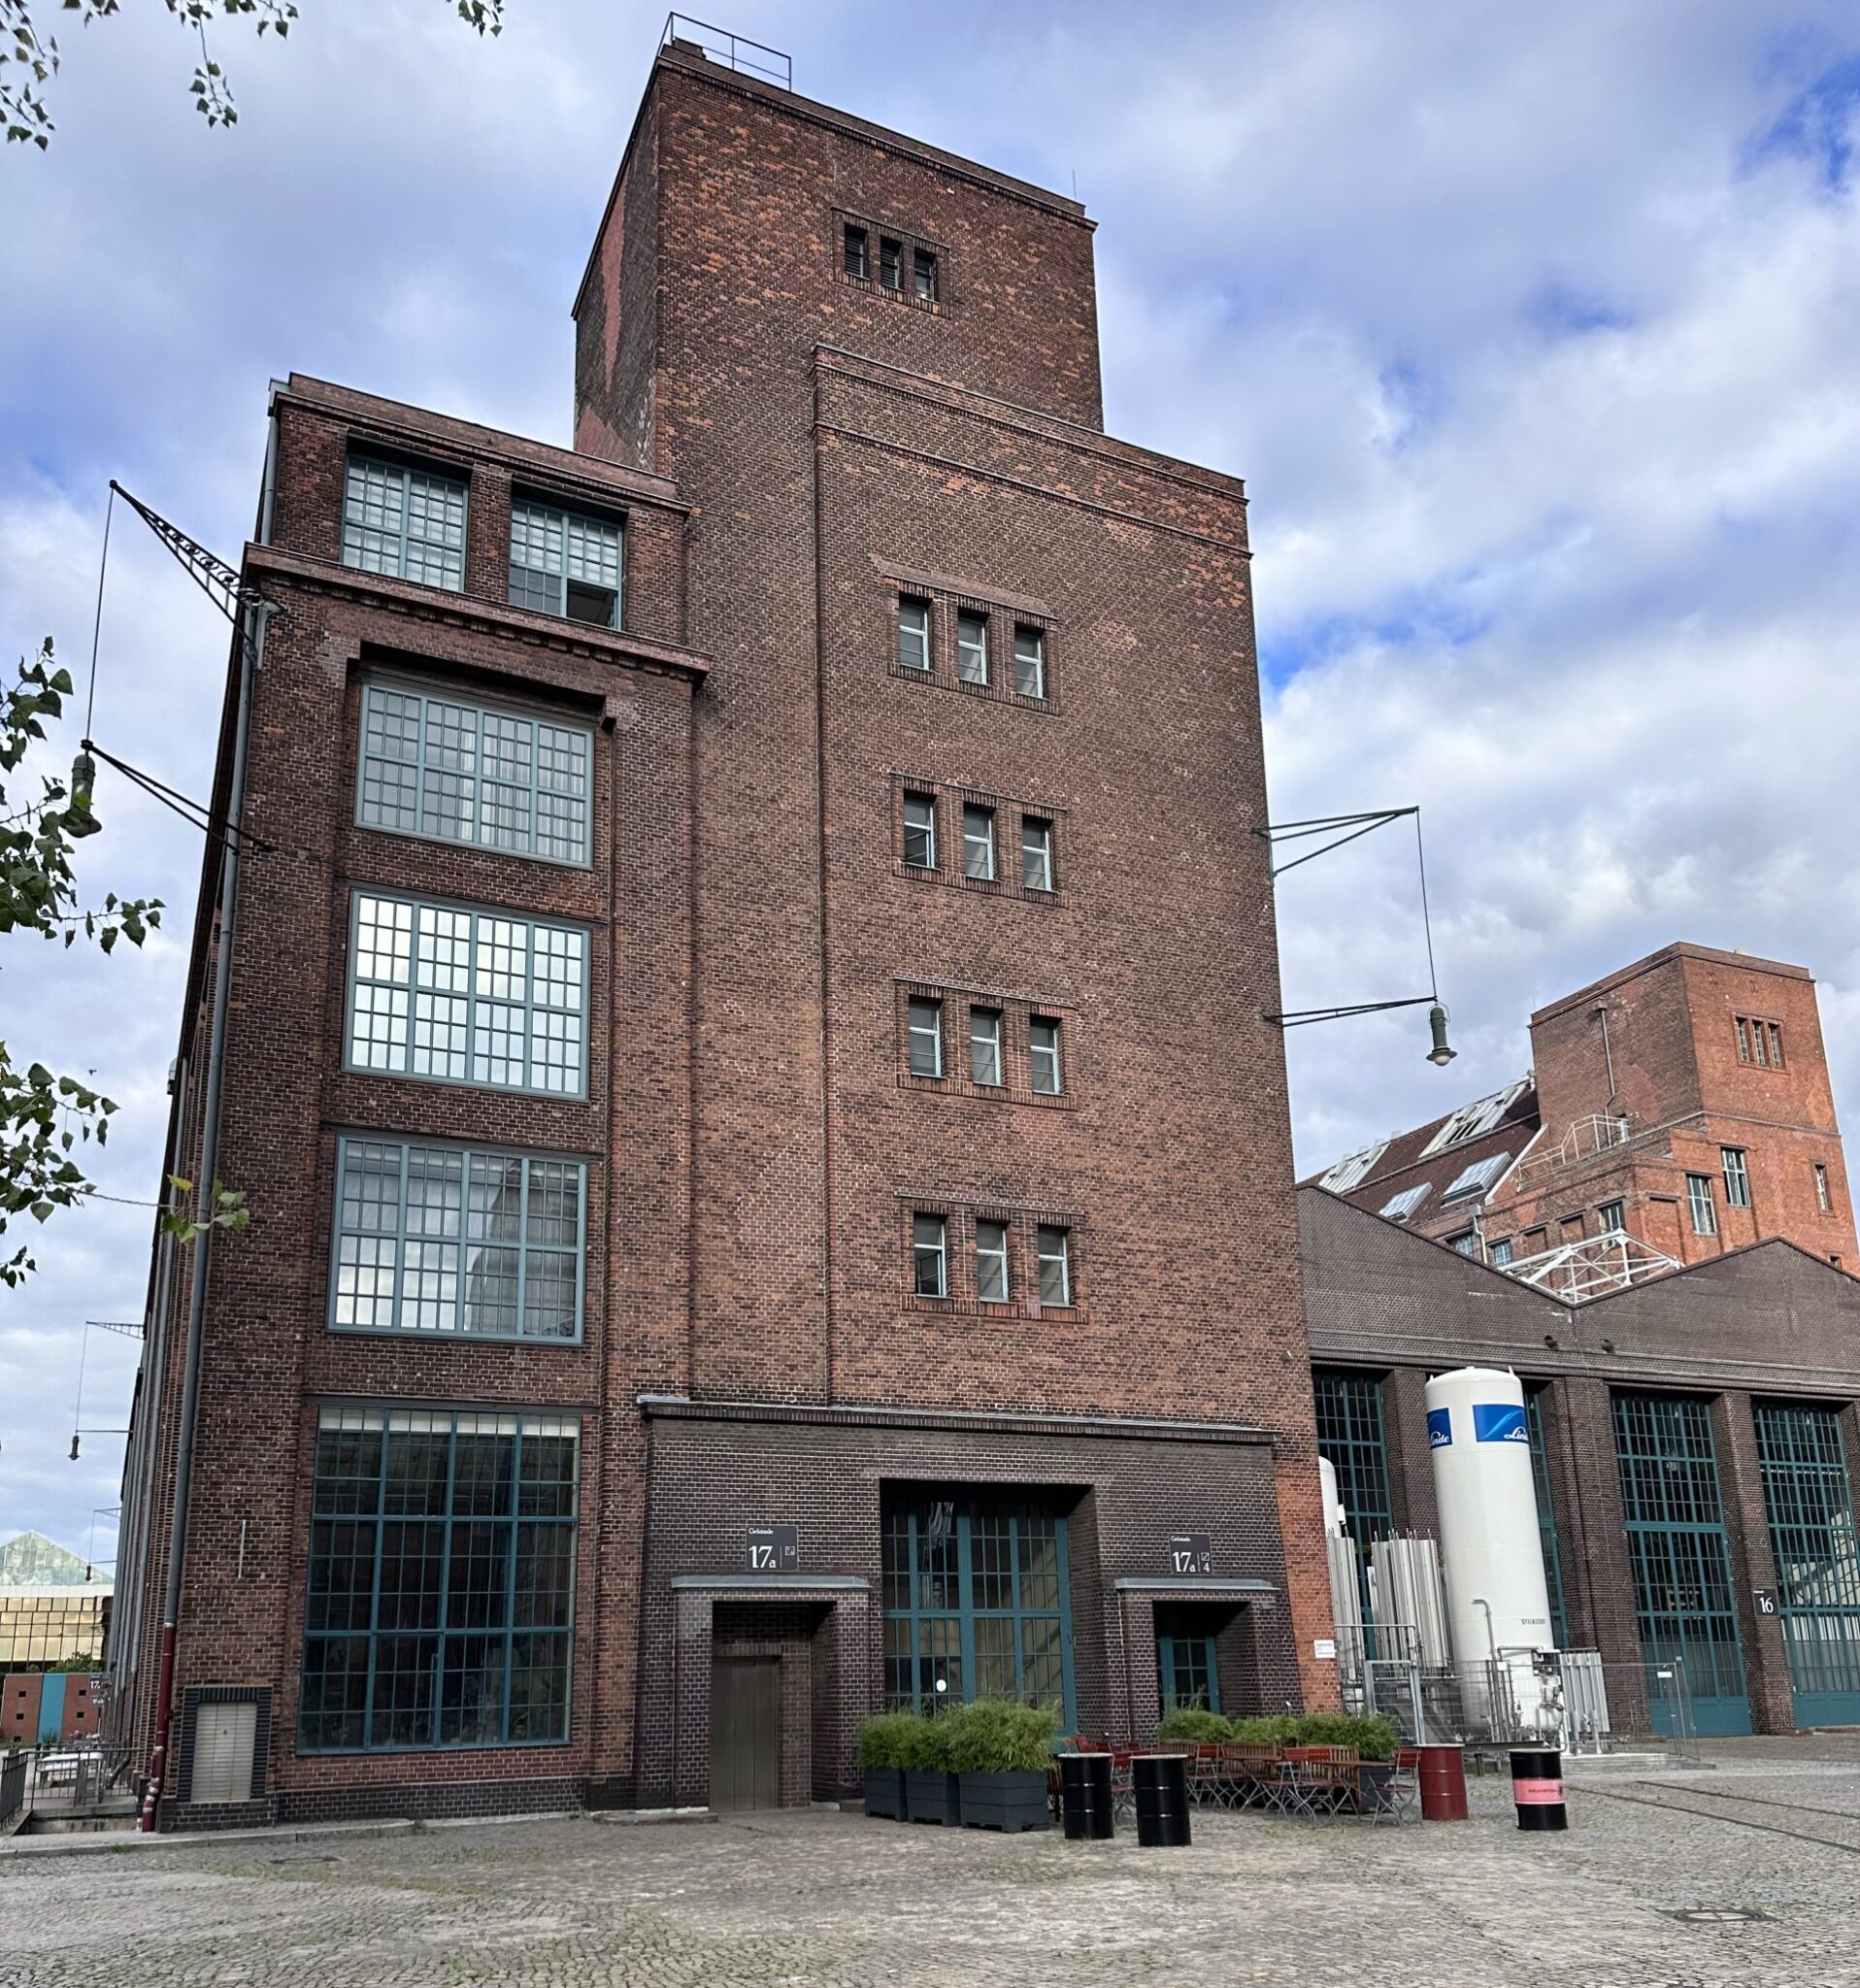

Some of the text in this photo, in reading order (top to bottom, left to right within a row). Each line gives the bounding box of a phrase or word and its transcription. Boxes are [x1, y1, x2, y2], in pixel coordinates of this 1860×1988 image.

[748, 1545, 777, 1569] 17a
[1172, 1551, 1196, 1573] 17a
[1203, 1562, 1211, 1573] 4
[1759, 1597, 1774, 1613] 16
